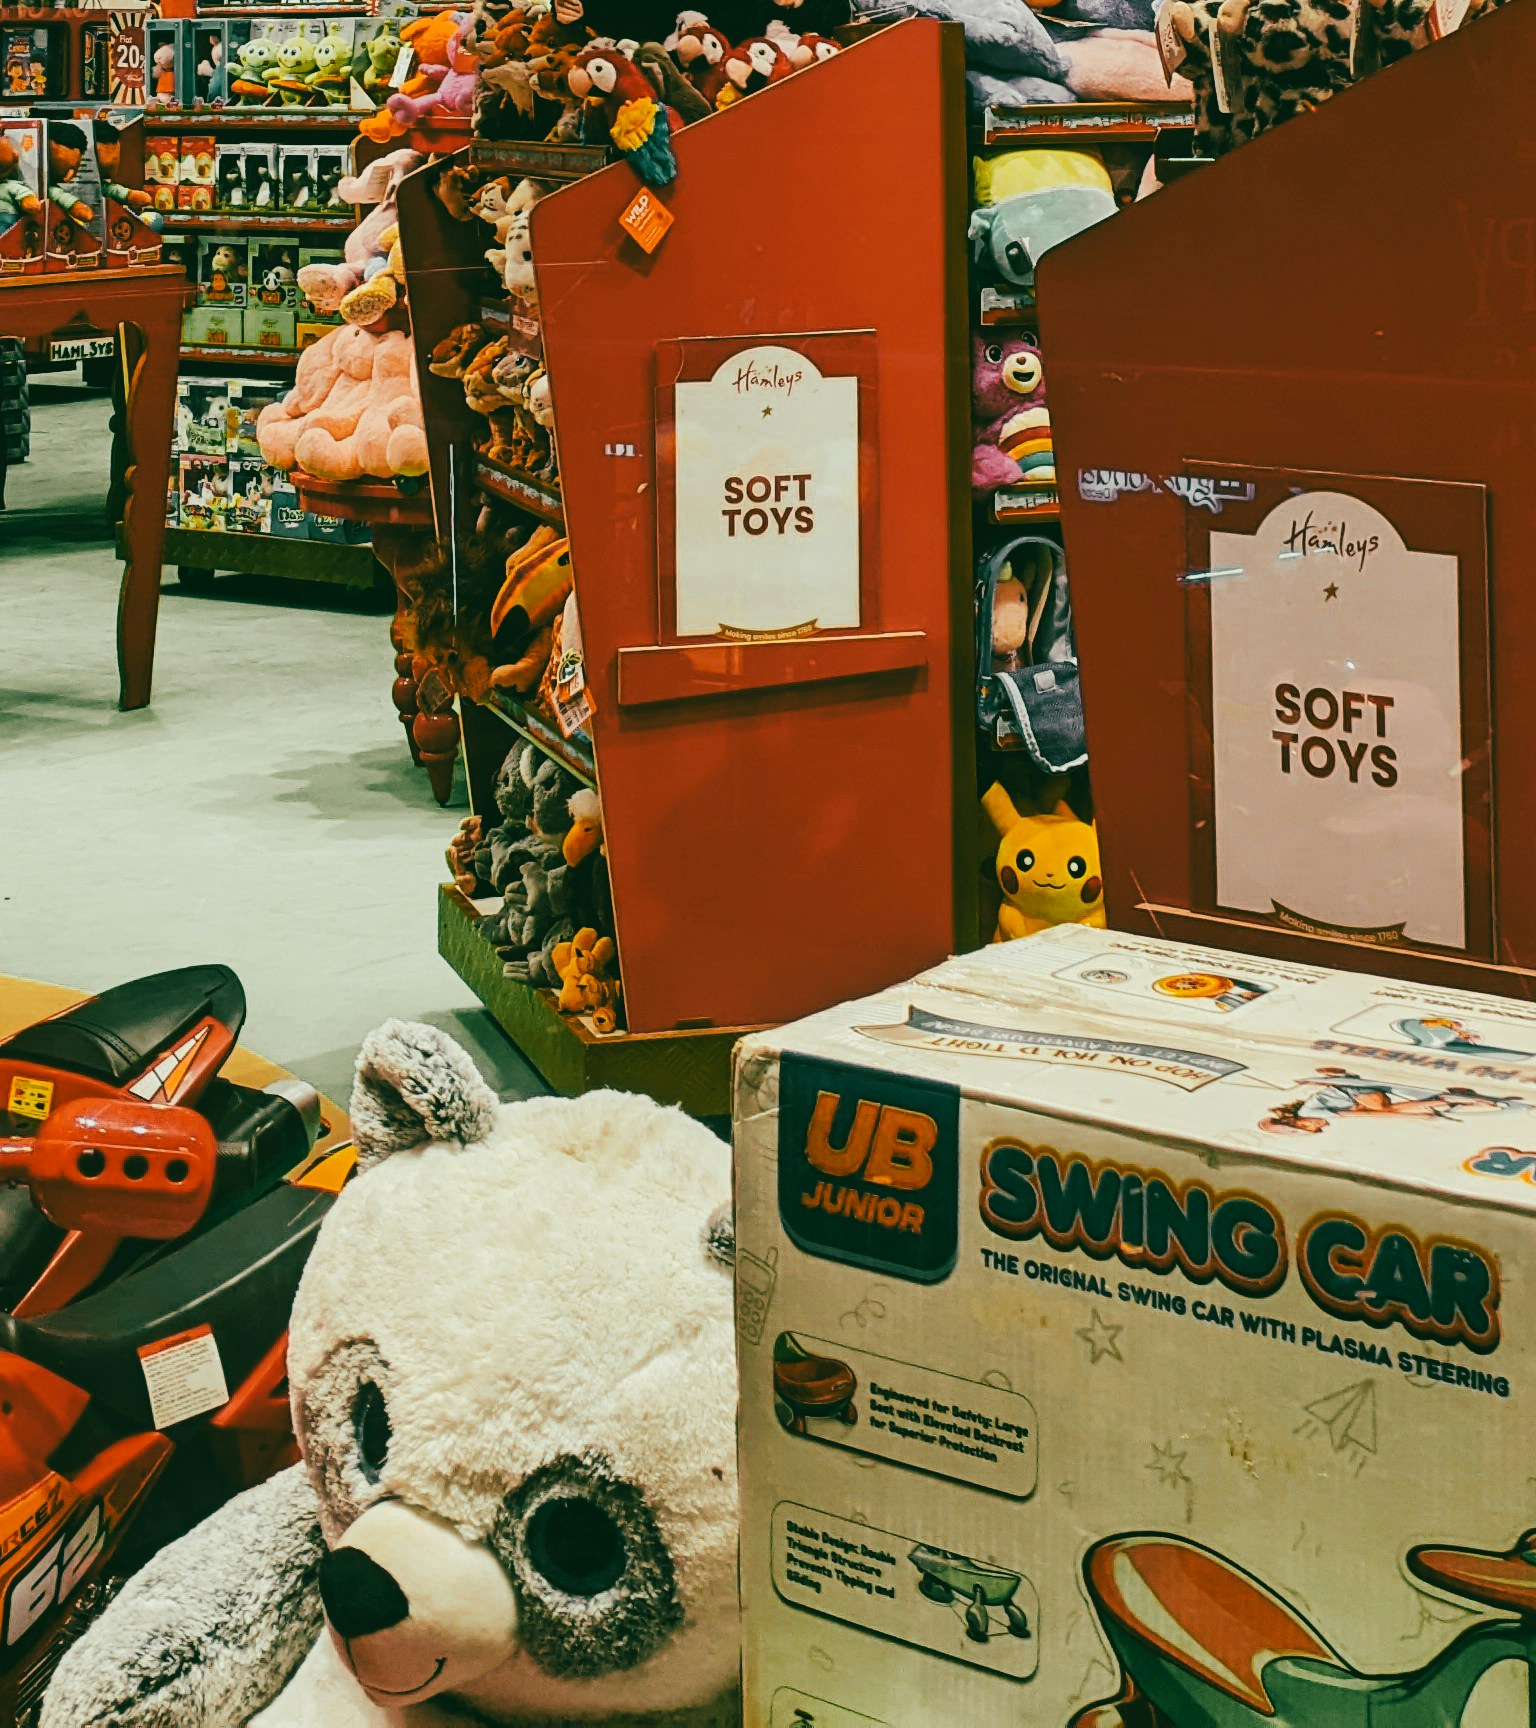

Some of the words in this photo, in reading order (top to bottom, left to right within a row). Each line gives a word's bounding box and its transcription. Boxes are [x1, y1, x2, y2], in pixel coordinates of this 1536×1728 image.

[624, 194, 649, 225] WILD
[732, 359, 802, 397] Hamleys
[724, 473, 812, 505] SOFT
[721, 505, 814, 538] TOYS
[1283, 510, 1380, 573] Hamleys
[724, 628, 752, 642] Making
[777, 630, 797, 640] since
[1275, 682, 1395, 738] SOFT
[1271, 730, 1399, 788] TOYS
[1279, 911, 1314, 934] Making
[1350, 933, 1376, 943] since
[1377, 930, 1398, 943] 1760
[929, 1037, 1007, 1054] TIGHT
[1311, 1038, 1459, 1072] WHEELS
[1154, 1063, 1213, 1081] HOP
[805, 1090, 938, 1190] UB
[801, 1182, 926, 1236] JUNIOR
[979, 1137, 1290, 1299] SWING
[1296, 1210, 1502, 1355] CAR
[981, 1248, 1019, 1275] THE
[1117, 1281, 1187, 1317] SWING
[1192, 1298, 1234, 1329] CAR
[1240, 1309, 1297, 1344] WITH
[1301, 1325, 1393, 1369] PLASMA
[1397, 1349, 1511, 1398] STEERING
[869, 1381, 929, 1410] Engineered
[932, 1400, 950, 1414] for
[994, 1417, 1029, 1439] Large
[869, 1398, 894, 1416] Seat
[896, 1407, 921, 1423] with
[923, 1414, 971, 1438] Elevated
[973, 1427, 1025, 1454] Backrest
[869, 1415, 886, 1429] for
[888, 1420, 937, 1444] Superior
[939, 1434, 998, 1463] Protection
[6, 1503, 106, 1647] 62
[786, 1535, 829, 1560] Triangle
[831, 1551, 882, 1578] Structure
[786, 1552, 833, 1578] Prevents
[835, 1568, 873, 1595] Tipping
[875, 1585, 895, 1599] and
